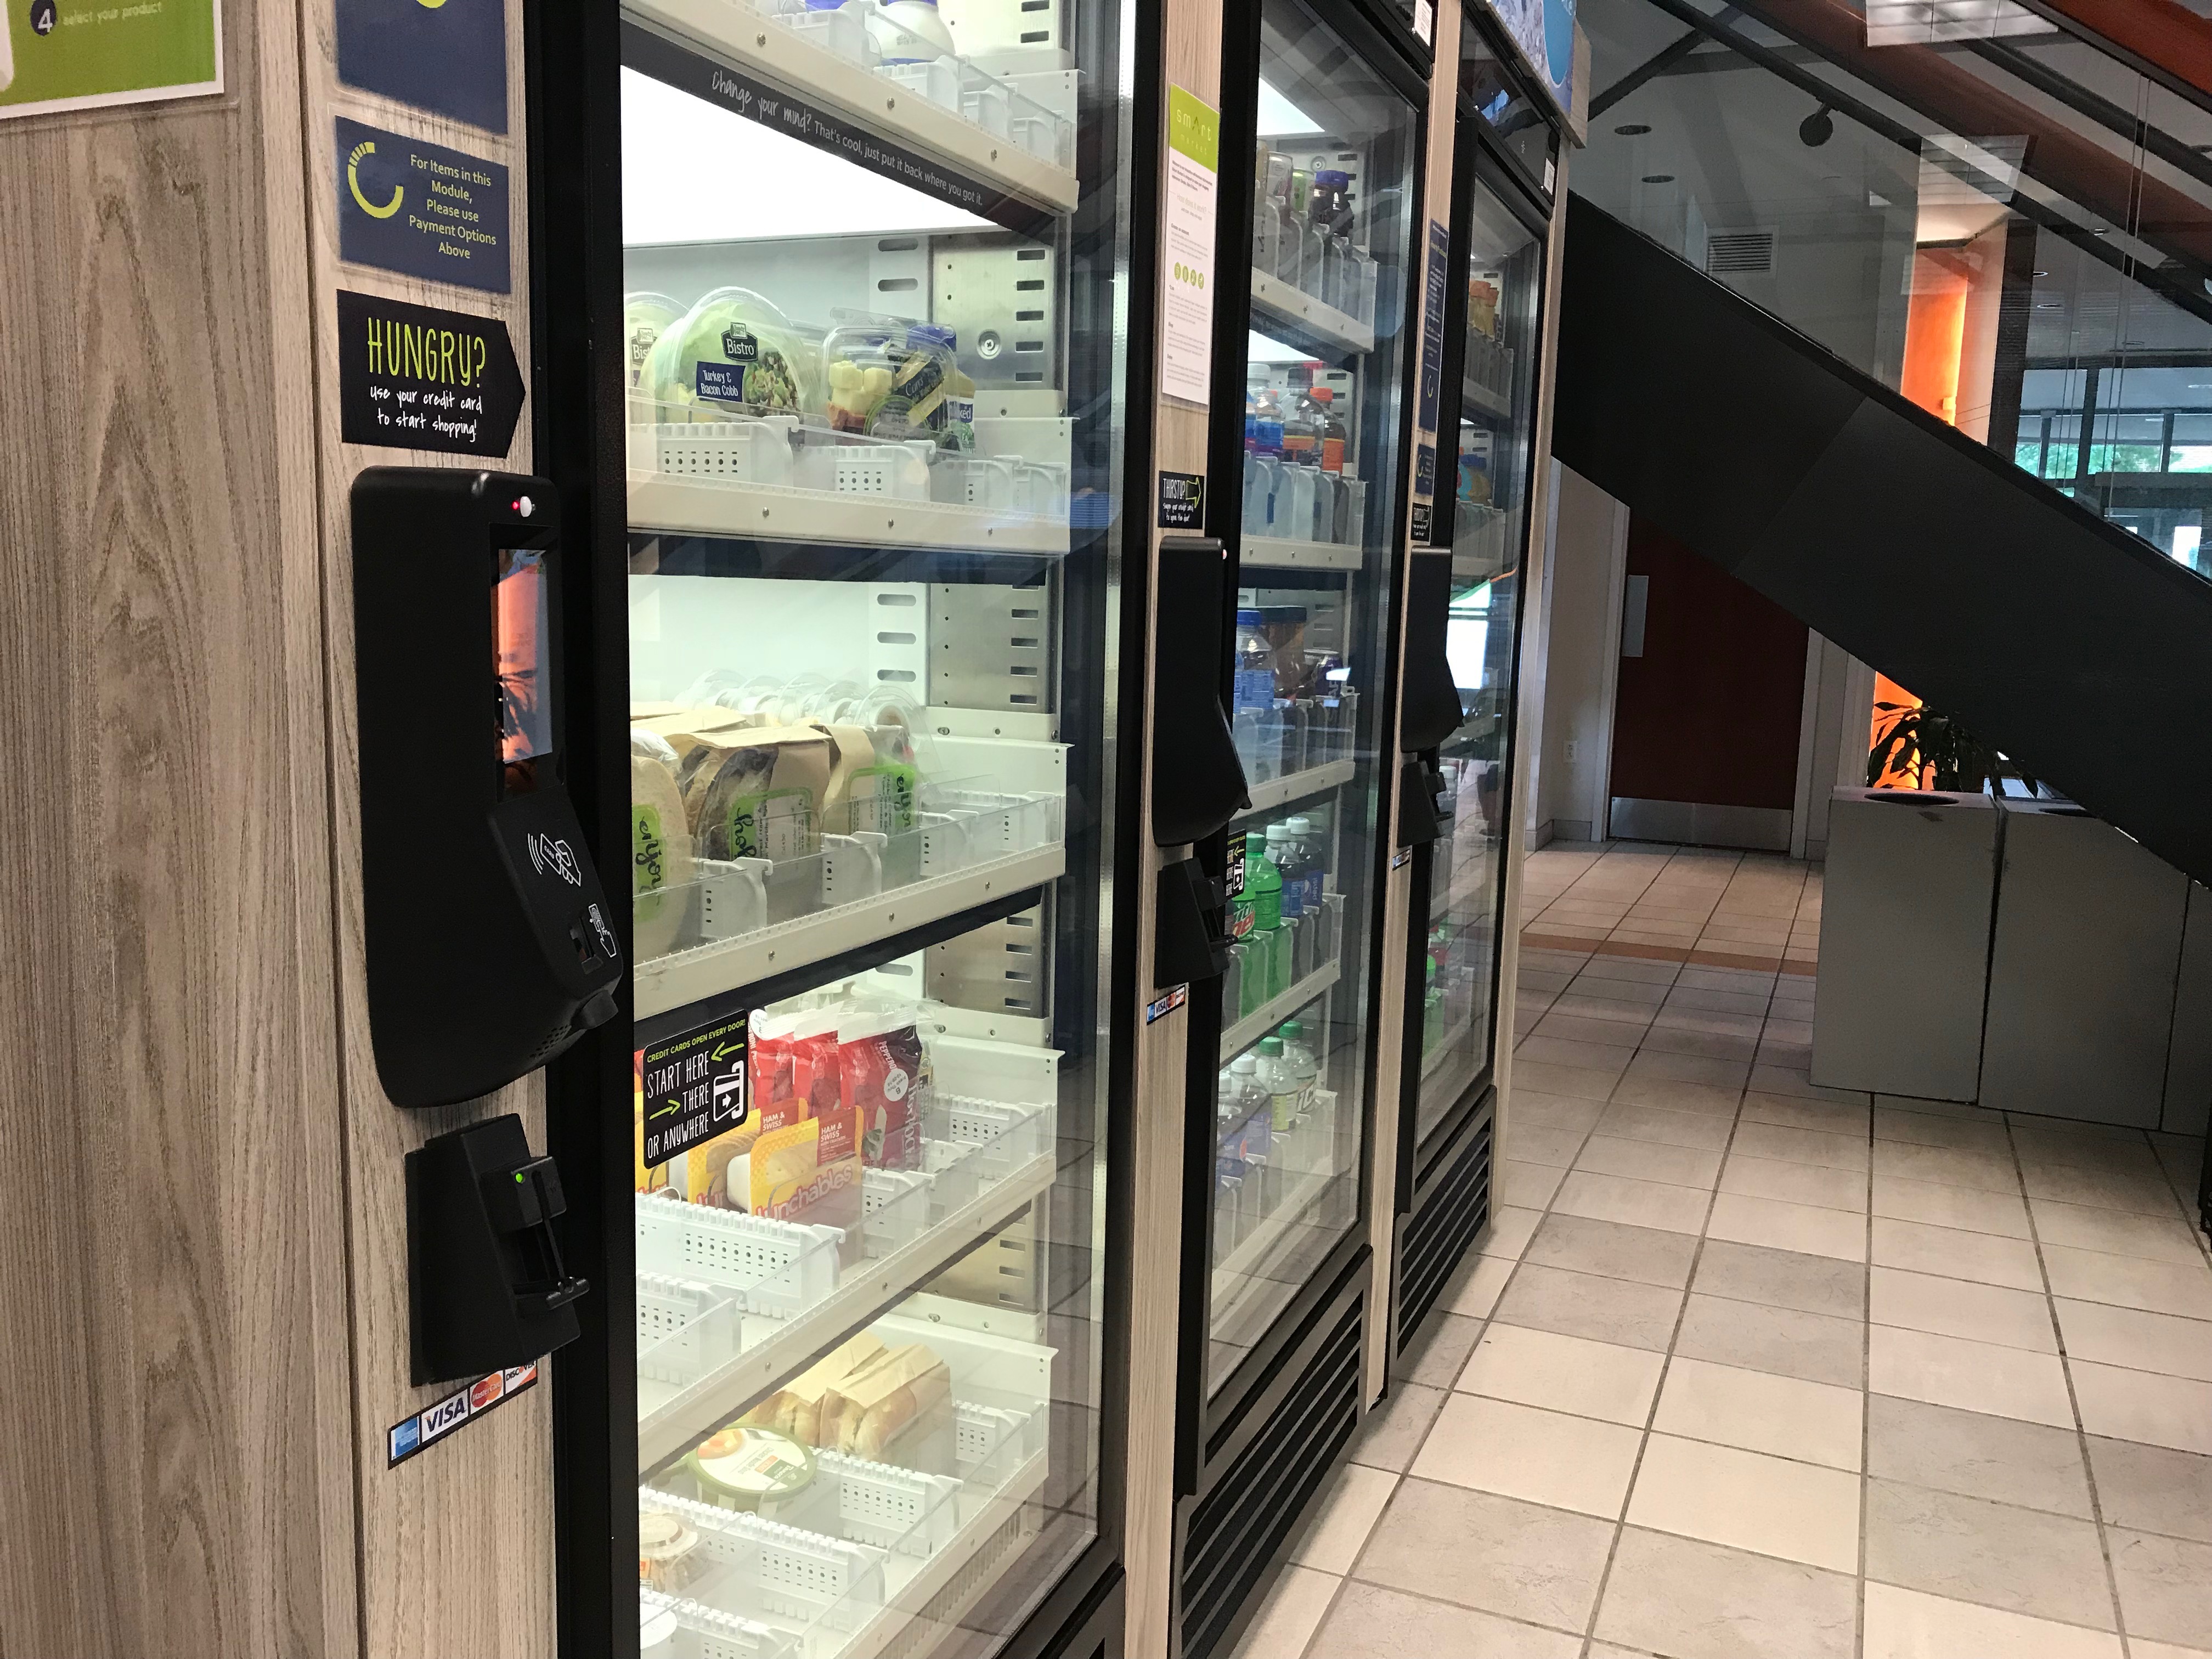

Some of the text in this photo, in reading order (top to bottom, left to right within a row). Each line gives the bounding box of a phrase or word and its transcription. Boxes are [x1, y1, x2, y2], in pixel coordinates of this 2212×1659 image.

[38, 2, 162, 32] 4 select your product
[712, 70, 752, 113] Change
[758, 97, 778, 120] your
[783, 108, 812, 133] mind?
[815, 120, 840, 144] That's
[843, 137, 862, 156] cool,
[864, 143, 880, 161] just
[881, 154, 895, 168] put
[897, 158, 902, 171] it
[905, 162, 923, 180] back
[925, 172, 947, 190] where
[948, 182, 961, 196] you
[963, 190, 974, 203] got
[410, 154, 491, 187] For Items in this
[431, 180, 472, 204] Module,
[427, 199, 479, 222] Please use
[409, 215, 496, 245] Payment Options
[438, 242, 470, 259] Above
[368, 317, 486, 388] HUNGRY?
[726, 338, 754, 356] Bistro
[702, 370, 731, 383] Turkey &
[397, 391, 417, 408] your
[423, 390, 455, 410] credit
[460, 396, 482, 414] card
[701, 383, 738, 397] Bacon Cobb
[377, 408, 477, 443] to start shopping!
[1156, 1000, 1166, 1014] VISA
[647, 1049, 669, 1063] CREDIT
[670, 1042, 690, 1054] CARDS
[691, 1035, 708, 1046] OPEN
[709, 1026, 726, 1039] EVERY
[727, 1019, 746, 1031] DOOR!
[647, 1050, 709, 1099] START HERE
[682, 1082, 709, 1113] THERE
[763, 1114, 778, 1124] HAM
[763, 1120, 782, 1131] SWISS
[821, 1125, 836, 1135] HAM
[647, 1111, 709, 1159] OR ANYWHERE
[821, 1130, 840, 1142] SWISS
[425, 1397, 465, 1432] VISA
